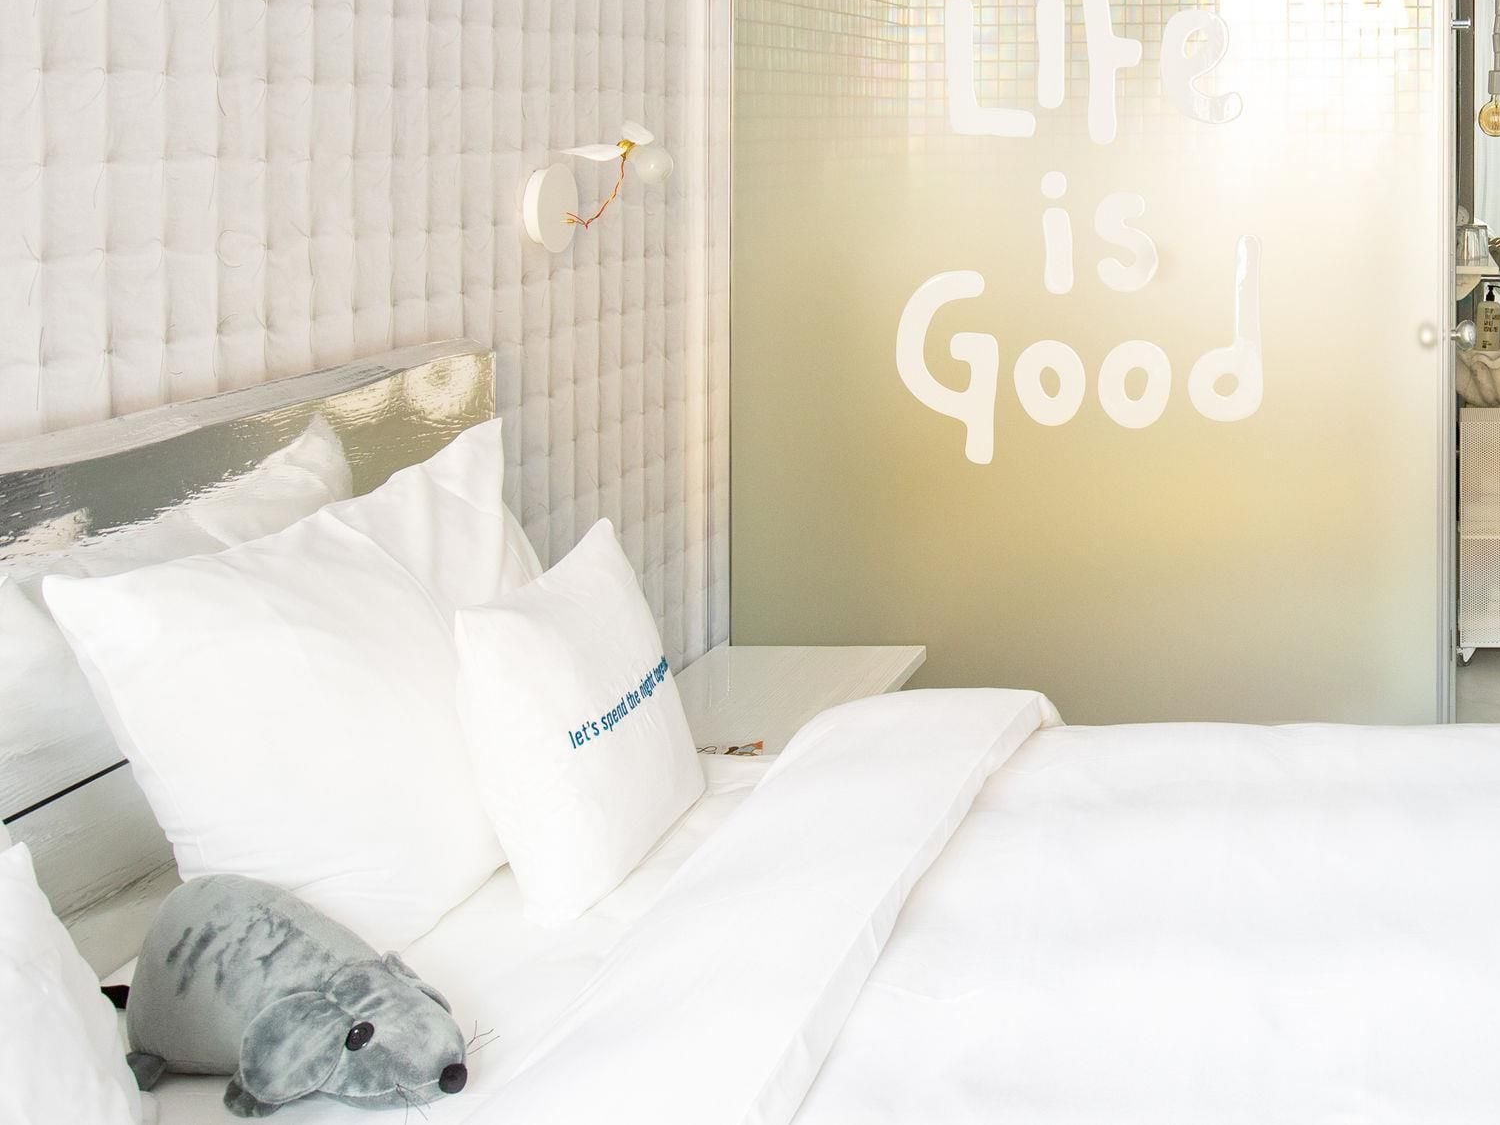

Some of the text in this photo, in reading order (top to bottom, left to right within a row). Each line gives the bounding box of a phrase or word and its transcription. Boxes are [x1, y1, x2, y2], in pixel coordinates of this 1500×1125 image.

[1041, 171, 1159, 295] is
[896, 234, 1263, 465] Good
[568, 720, 600, 749] let's
[600, 697, 628, 732] spend
[626, 691, 641, 710] the
[640, 671, 657, 699] night
